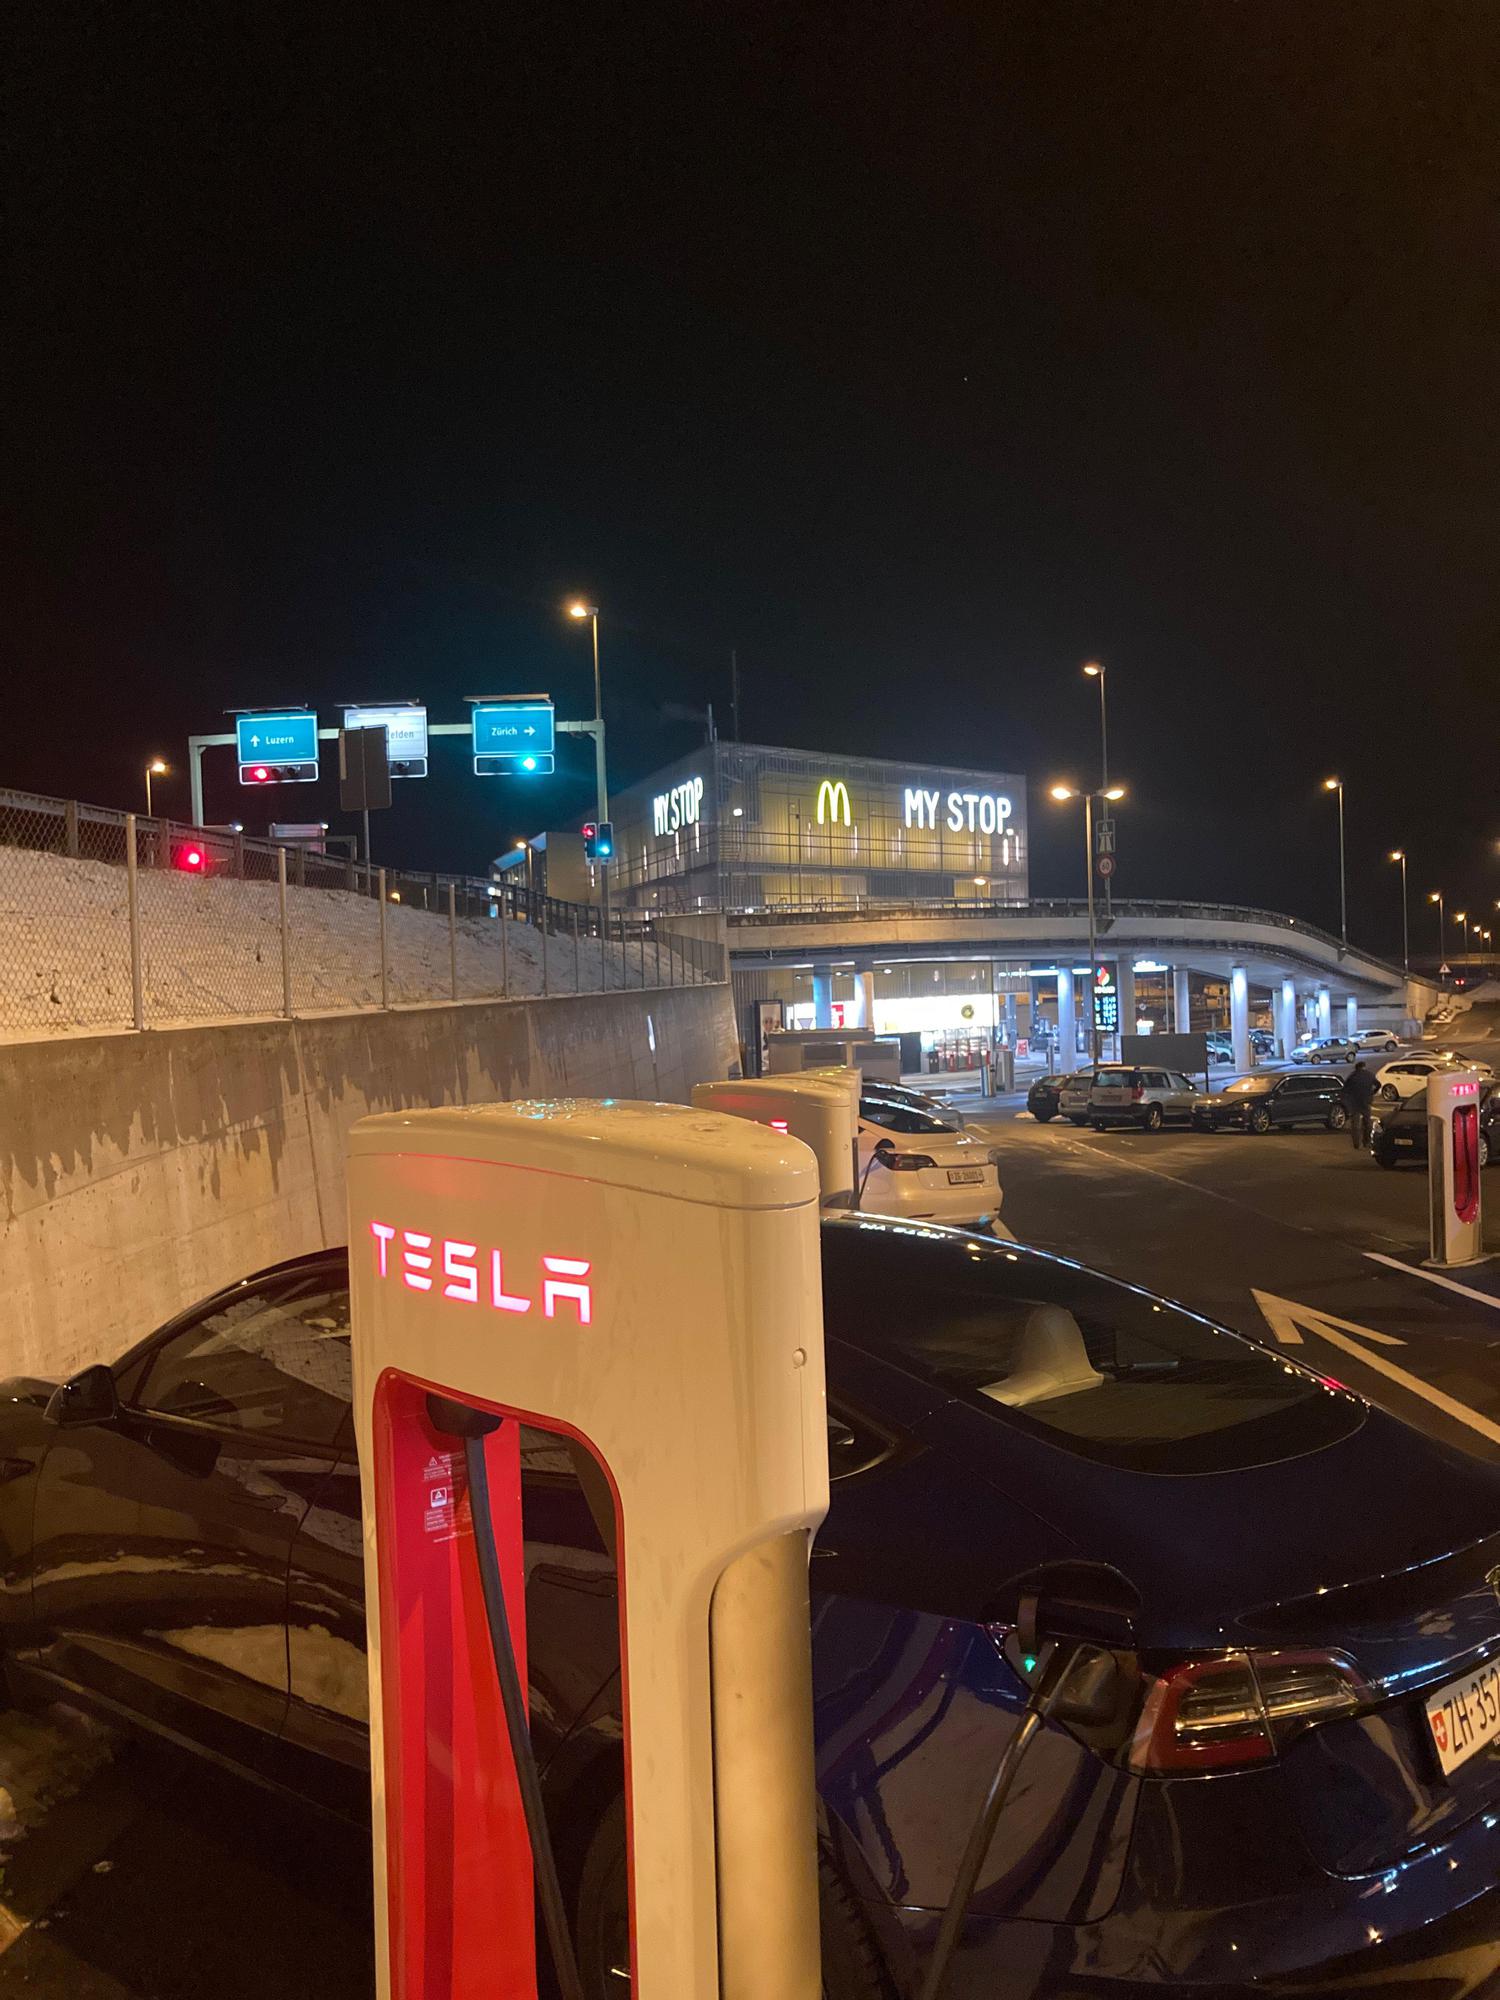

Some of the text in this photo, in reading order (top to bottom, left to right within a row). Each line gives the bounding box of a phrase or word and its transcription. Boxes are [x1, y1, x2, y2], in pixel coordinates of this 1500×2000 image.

[265, 735, 295, 745] Luzern
[390, 729, 414, 739] elden
[491, 726, 518, 737] Zürich
[653, 777, 704, 837] MY STOP
[904, 787, 940, 830] MY
[370, 1221, 592, 1324] TESLA
